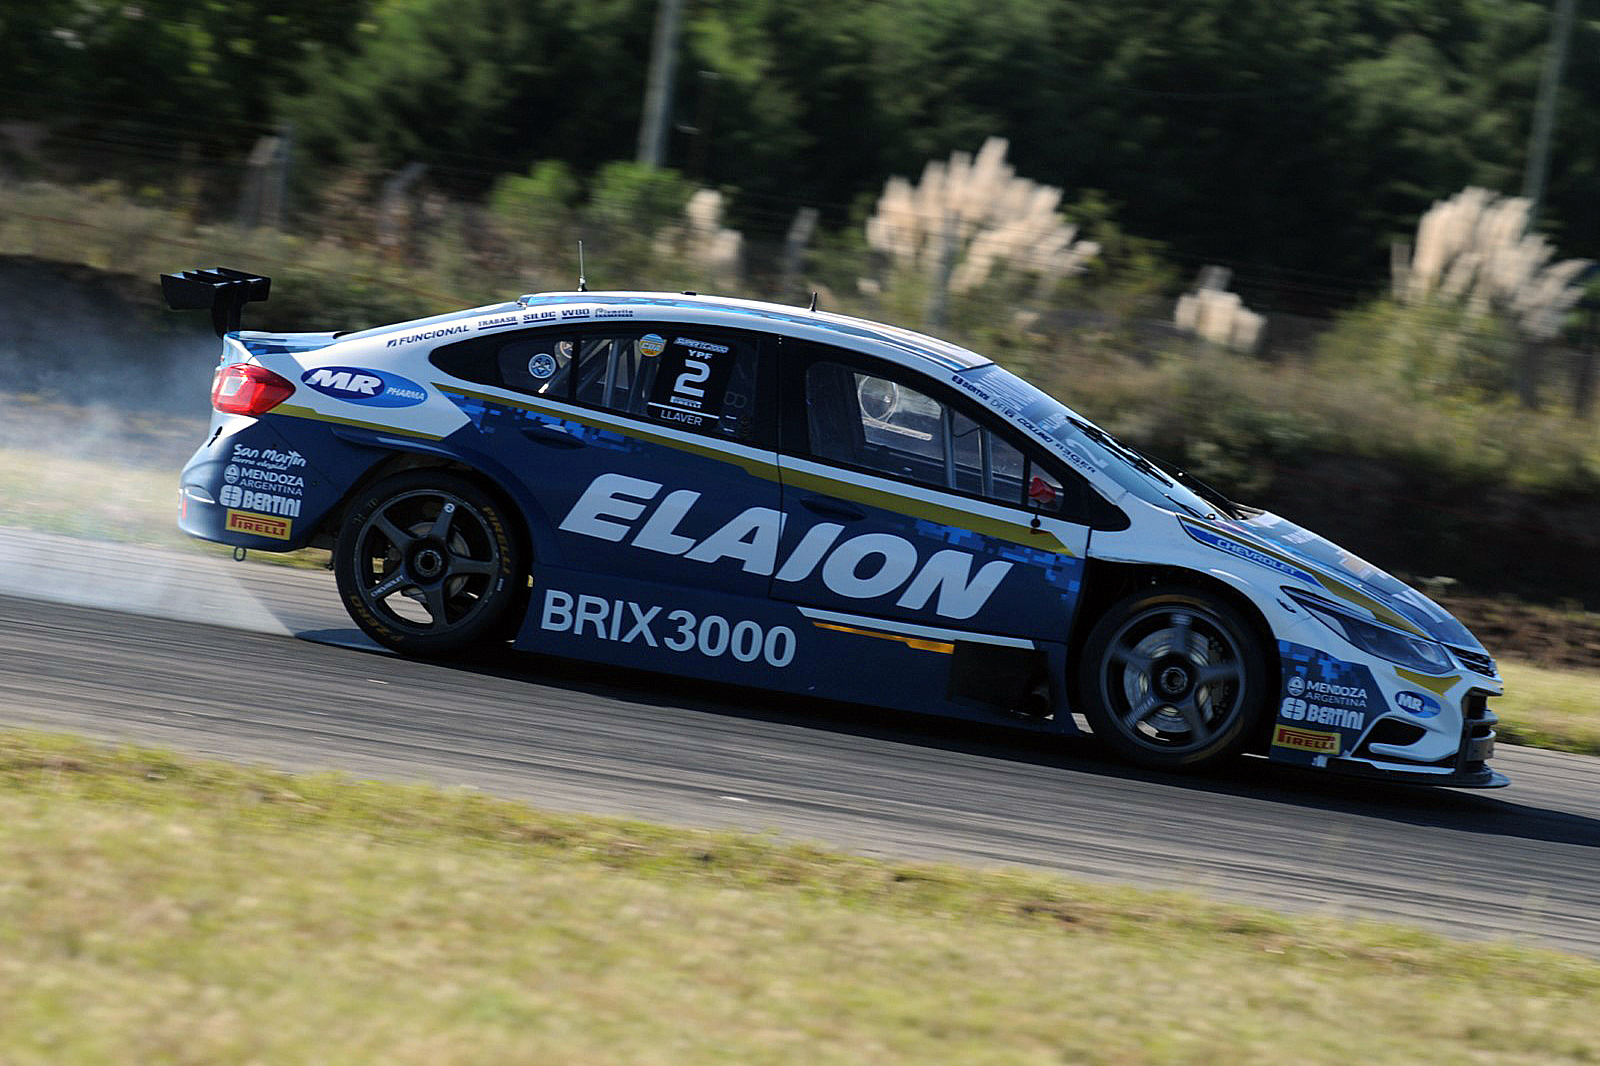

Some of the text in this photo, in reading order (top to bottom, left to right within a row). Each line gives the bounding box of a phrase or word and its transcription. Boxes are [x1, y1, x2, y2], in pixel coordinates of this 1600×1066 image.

[399, 325, 470, 346] FUNCIONAL
[688, 349, 713, 360] YPF
[304, 369, 425, 401] MR PHARMA
[673, 358, 711, 397] 2
[660, 410, 703, 426] LLAVER
[233, 443, 260, 458] San
[239, 478, 303, 496] ARGENTINA
[240, 467, 304, 488] MENDOZA
[242, 490, 301, 517] BERTINI
[229, 513, 287, 536] PIRELLI
[558, 473, 1014, 620] ELAION
[1216, 539, 1299, 576] CHEVROLET
[1305, 692, 1367, 708] ARGENTINA
[1306, 680, 1368, 699] MENDOZA
[1398, 694, 1425, 712] MR
[1306, 704, 1365, 731] BERTINI
[1278, 728, 1336, 750] PIRELLI
